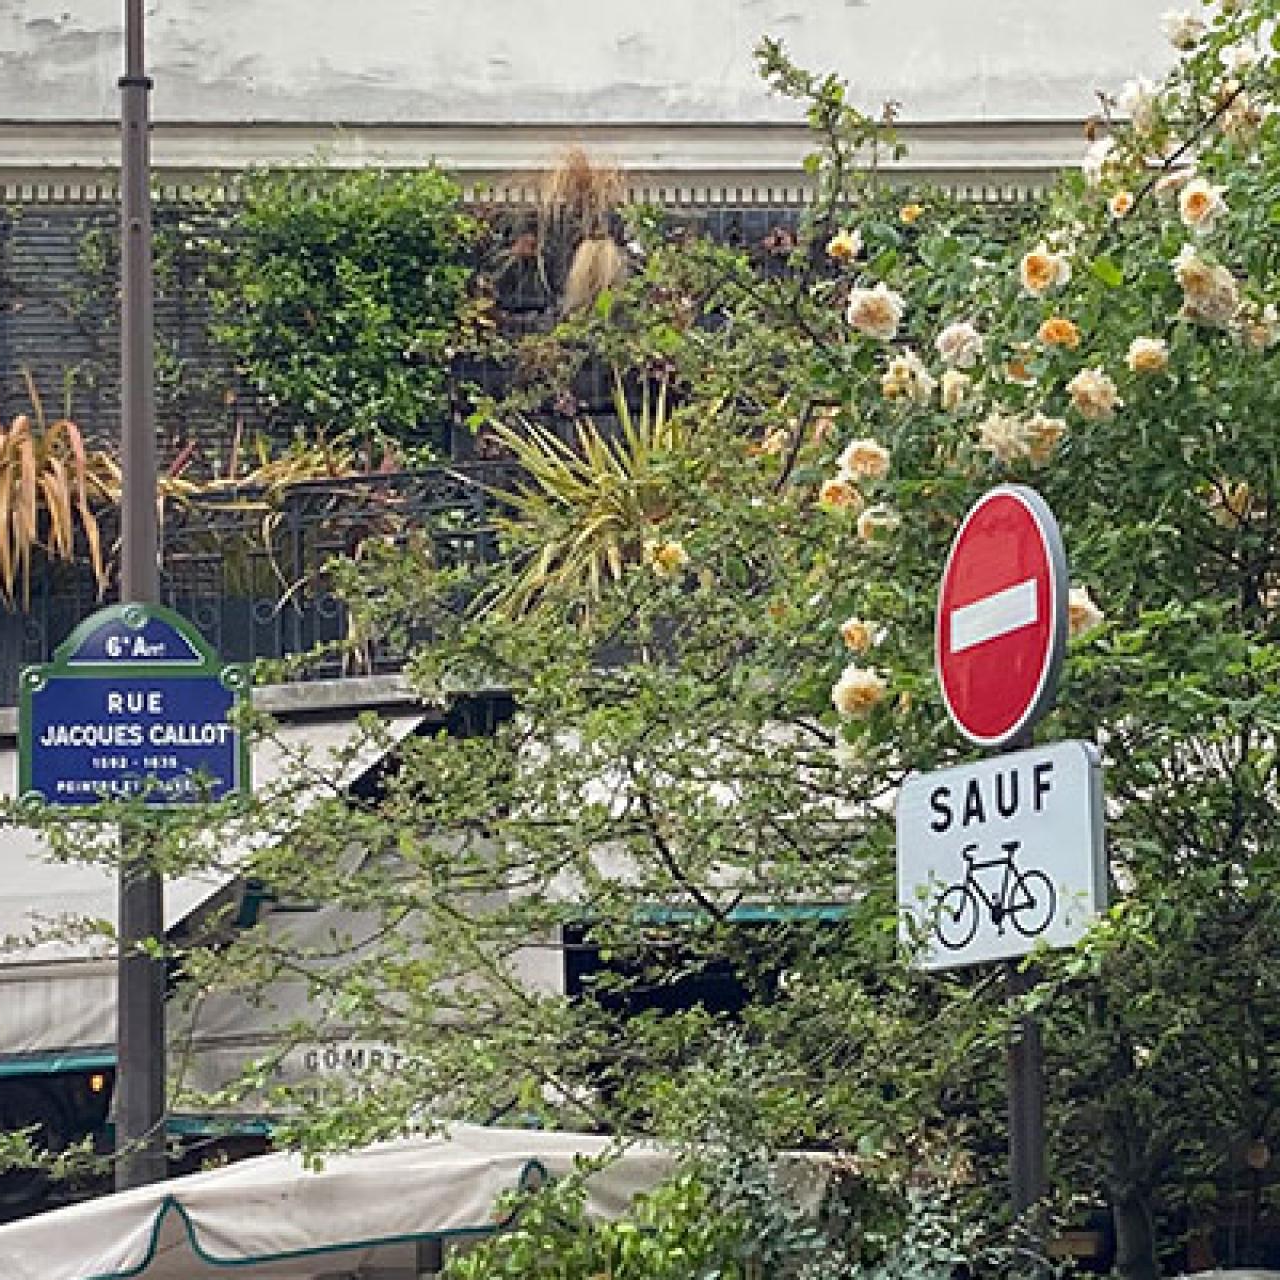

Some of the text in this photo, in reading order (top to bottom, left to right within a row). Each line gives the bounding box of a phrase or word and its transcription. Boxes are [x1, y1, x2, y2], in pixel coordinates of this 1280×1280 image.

[107, 692, 163, 714] RUE
[40, 722, 231, 746] JACQUES CALLOT
[930, 761, 1054, 832] SAUF
